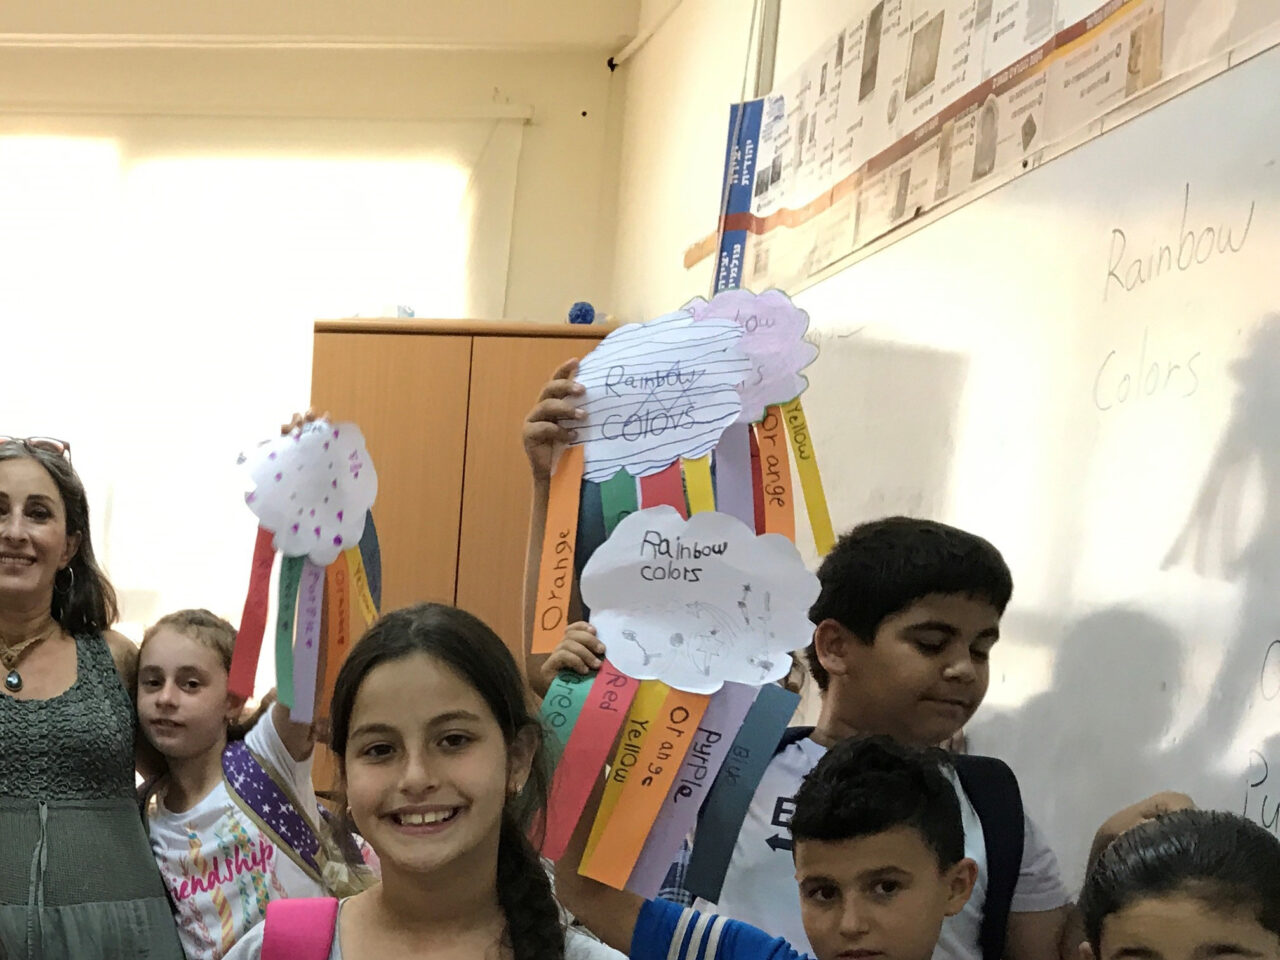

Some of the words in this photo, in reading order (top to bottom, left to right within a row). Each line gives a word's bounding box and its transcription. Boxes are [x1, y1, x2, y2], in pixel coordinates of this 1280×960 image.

[1102, 181, 1257, 304] Rainbow
[640, 528, 729, 560] Rainbow
[598, 672, 629, 713] Red
